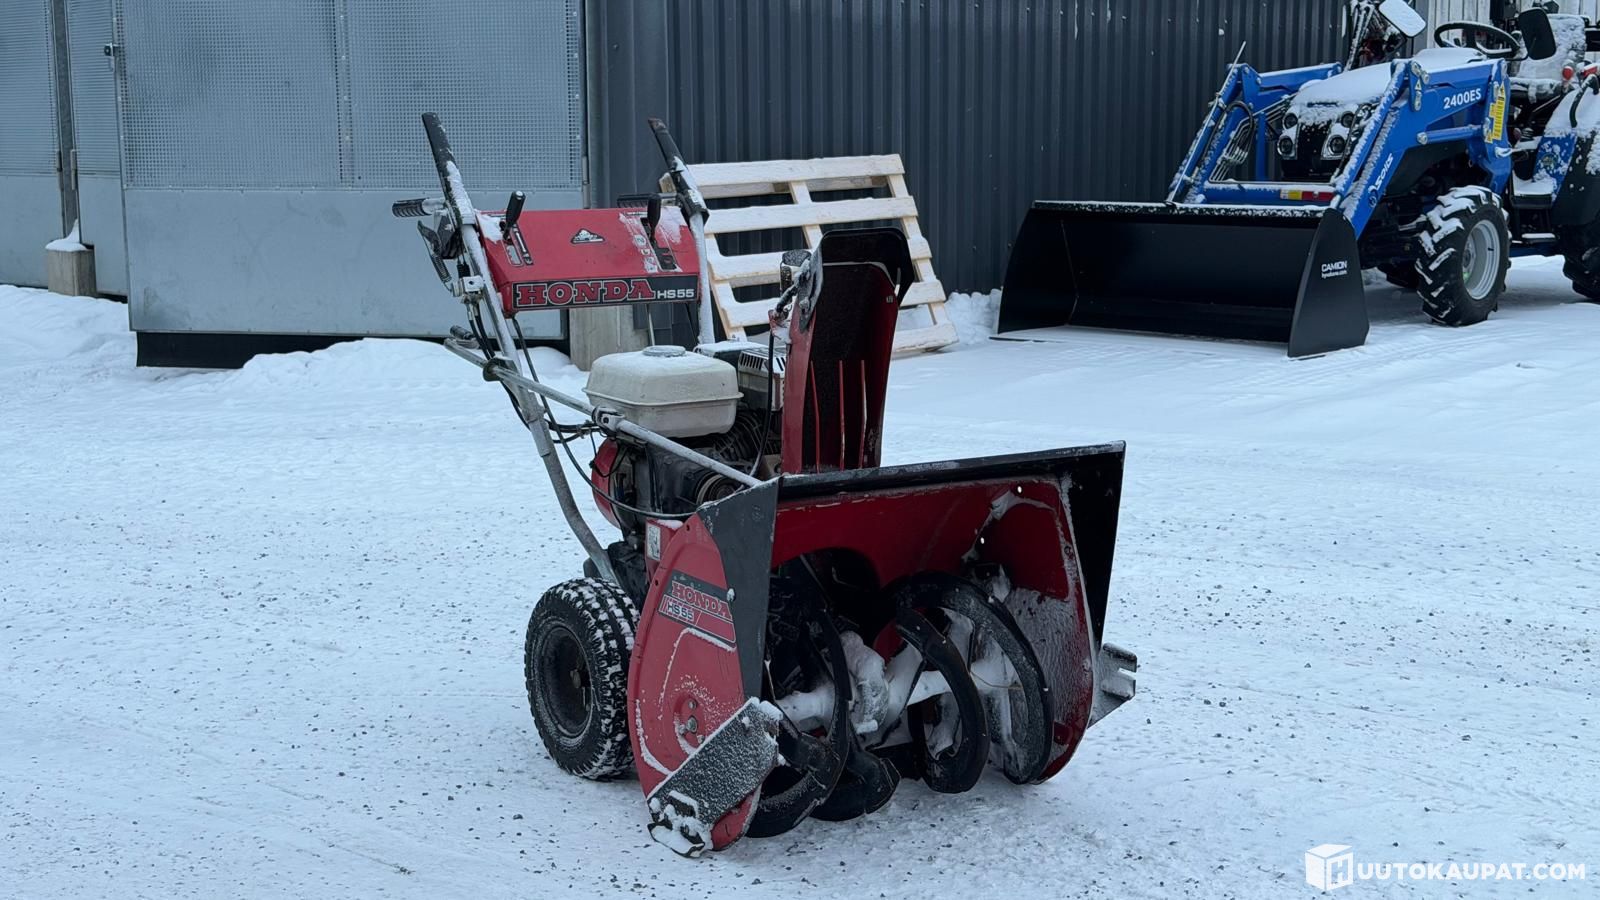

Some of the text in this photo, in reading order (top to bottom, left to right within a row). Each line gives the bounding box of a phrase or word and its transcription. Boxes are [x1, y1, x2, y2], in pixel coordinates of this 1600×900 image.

[1443, 88, 1482, 110] 2400ES
[517, 279, 695, 306] HONDA HS55
[666, 600, 696, 621] HS55
[671, 580, 733, 622] HONDA
